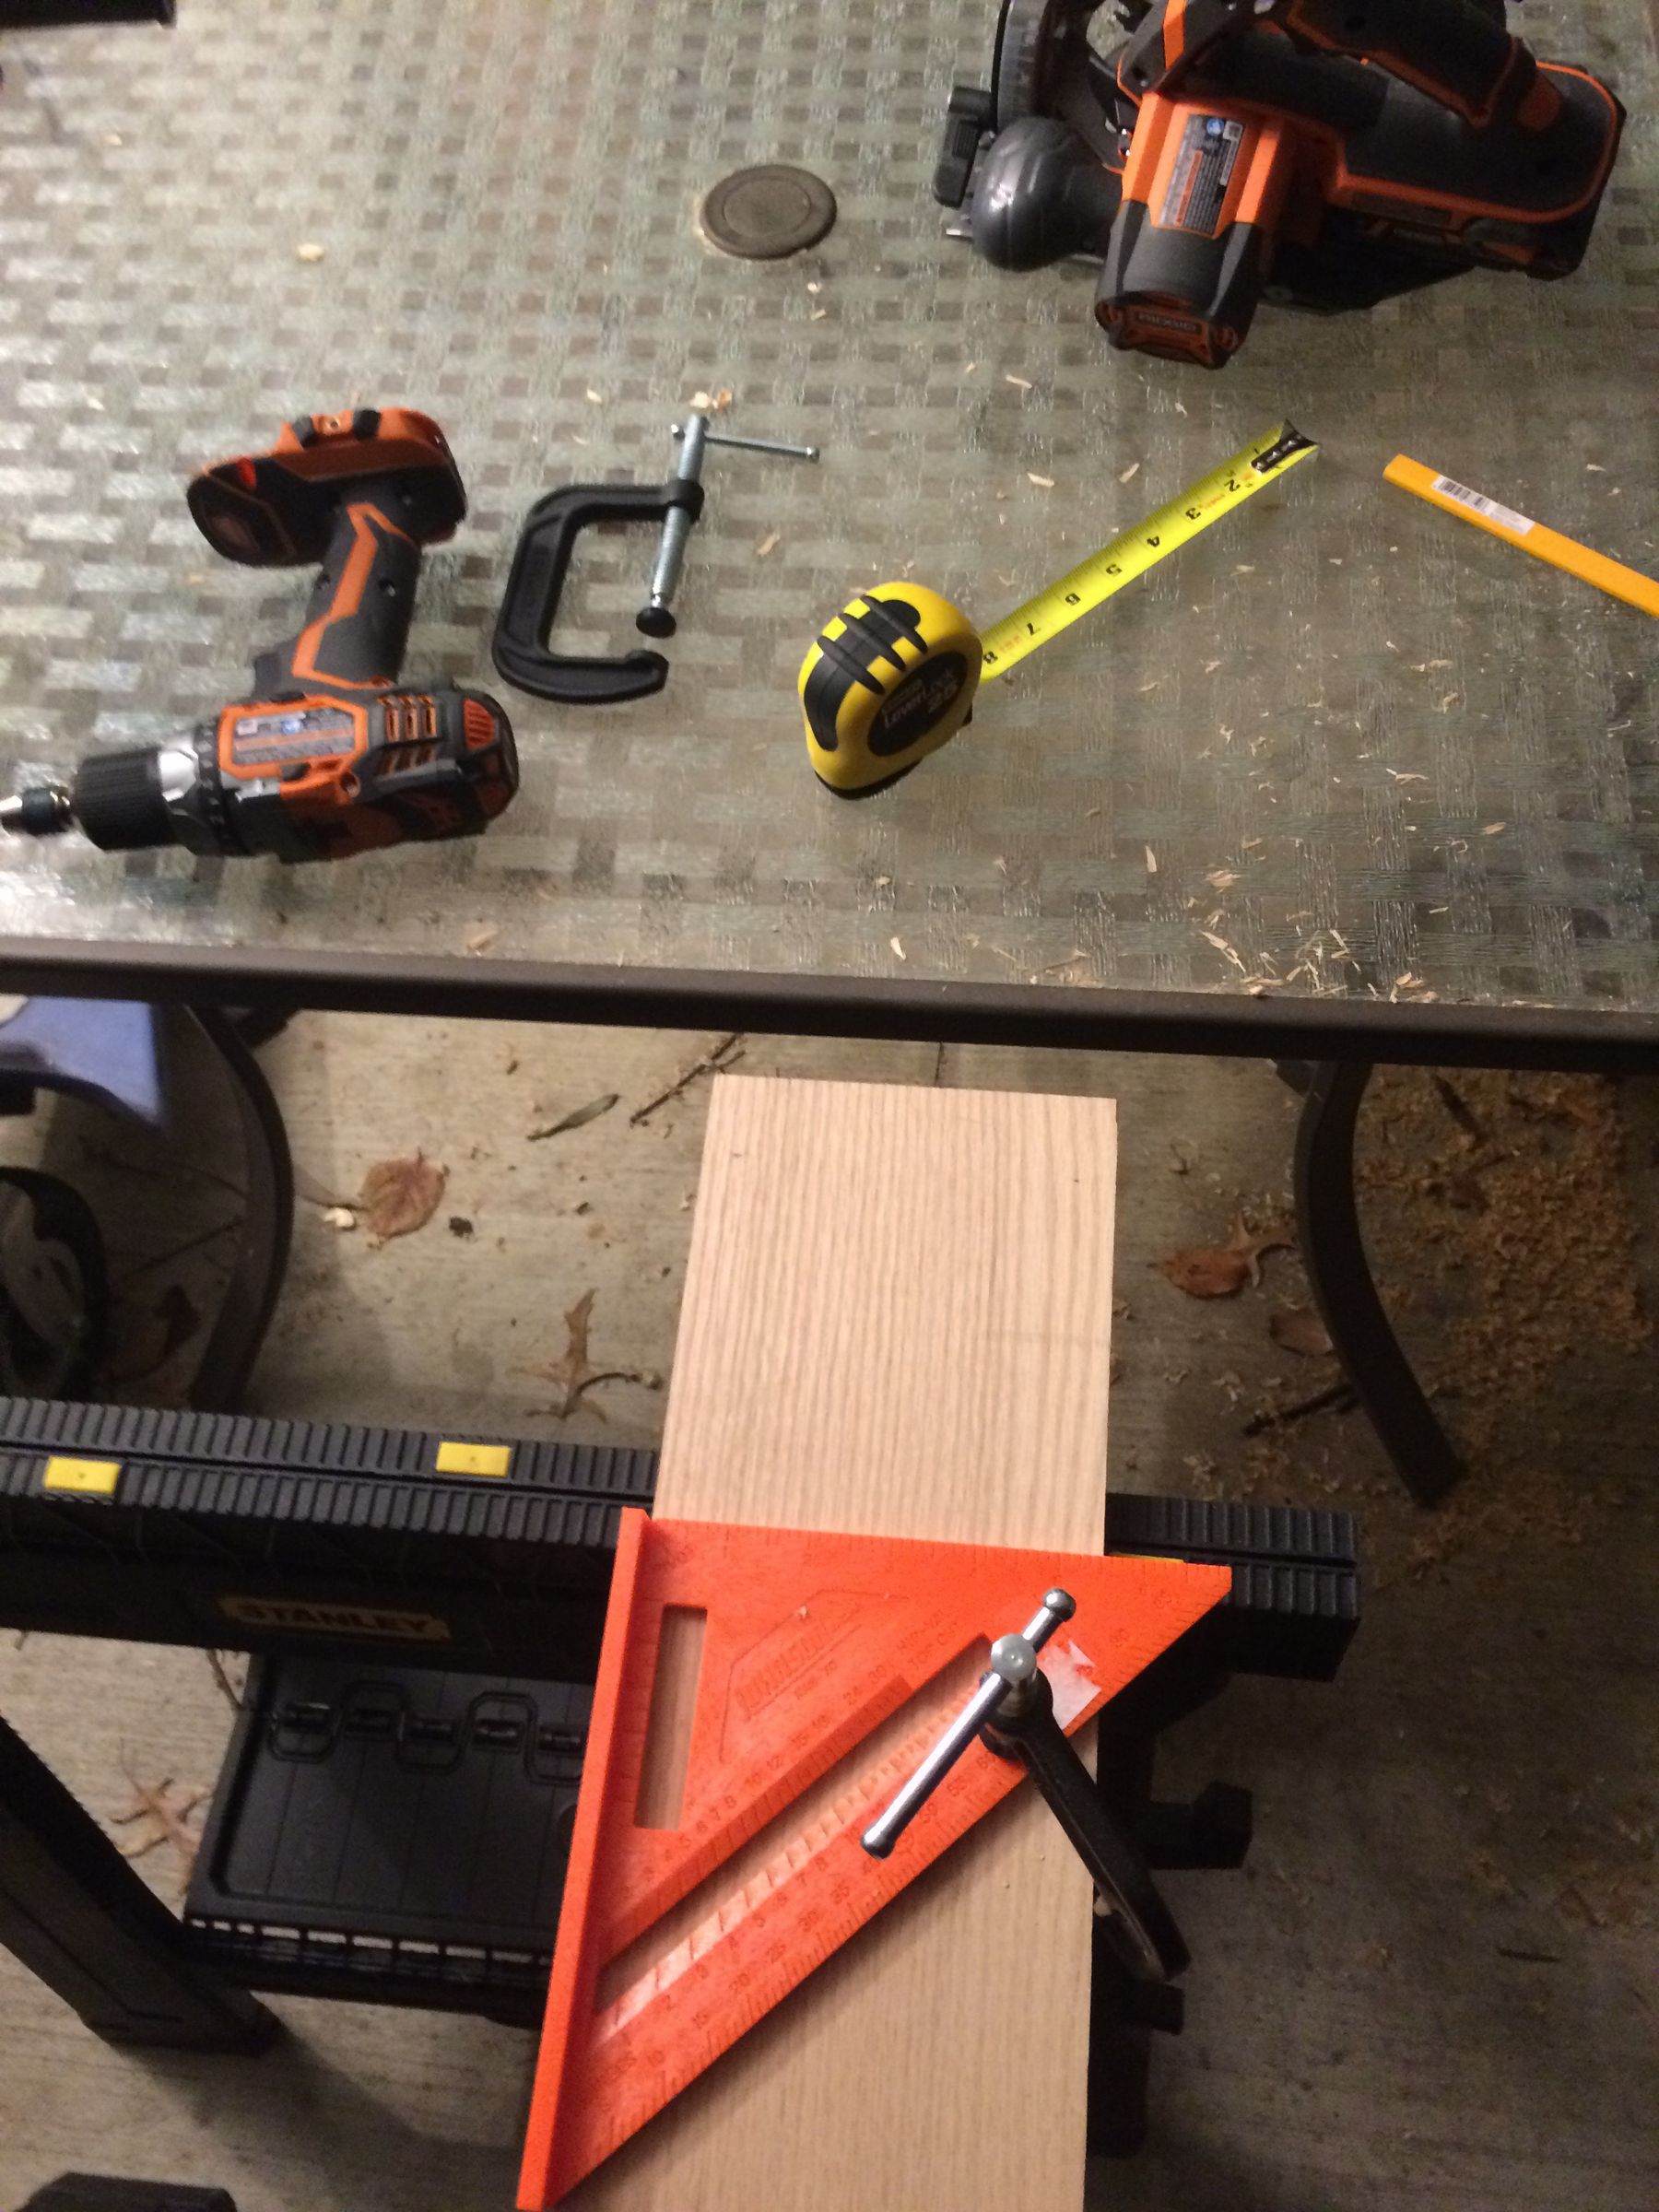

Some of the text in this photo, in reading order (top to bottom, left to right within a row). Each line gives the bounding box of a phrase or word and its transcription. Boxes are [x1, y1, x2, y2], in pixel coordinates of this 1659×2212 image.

[983, 479, 1241, 664] 2 3 4 5 6 7 8
